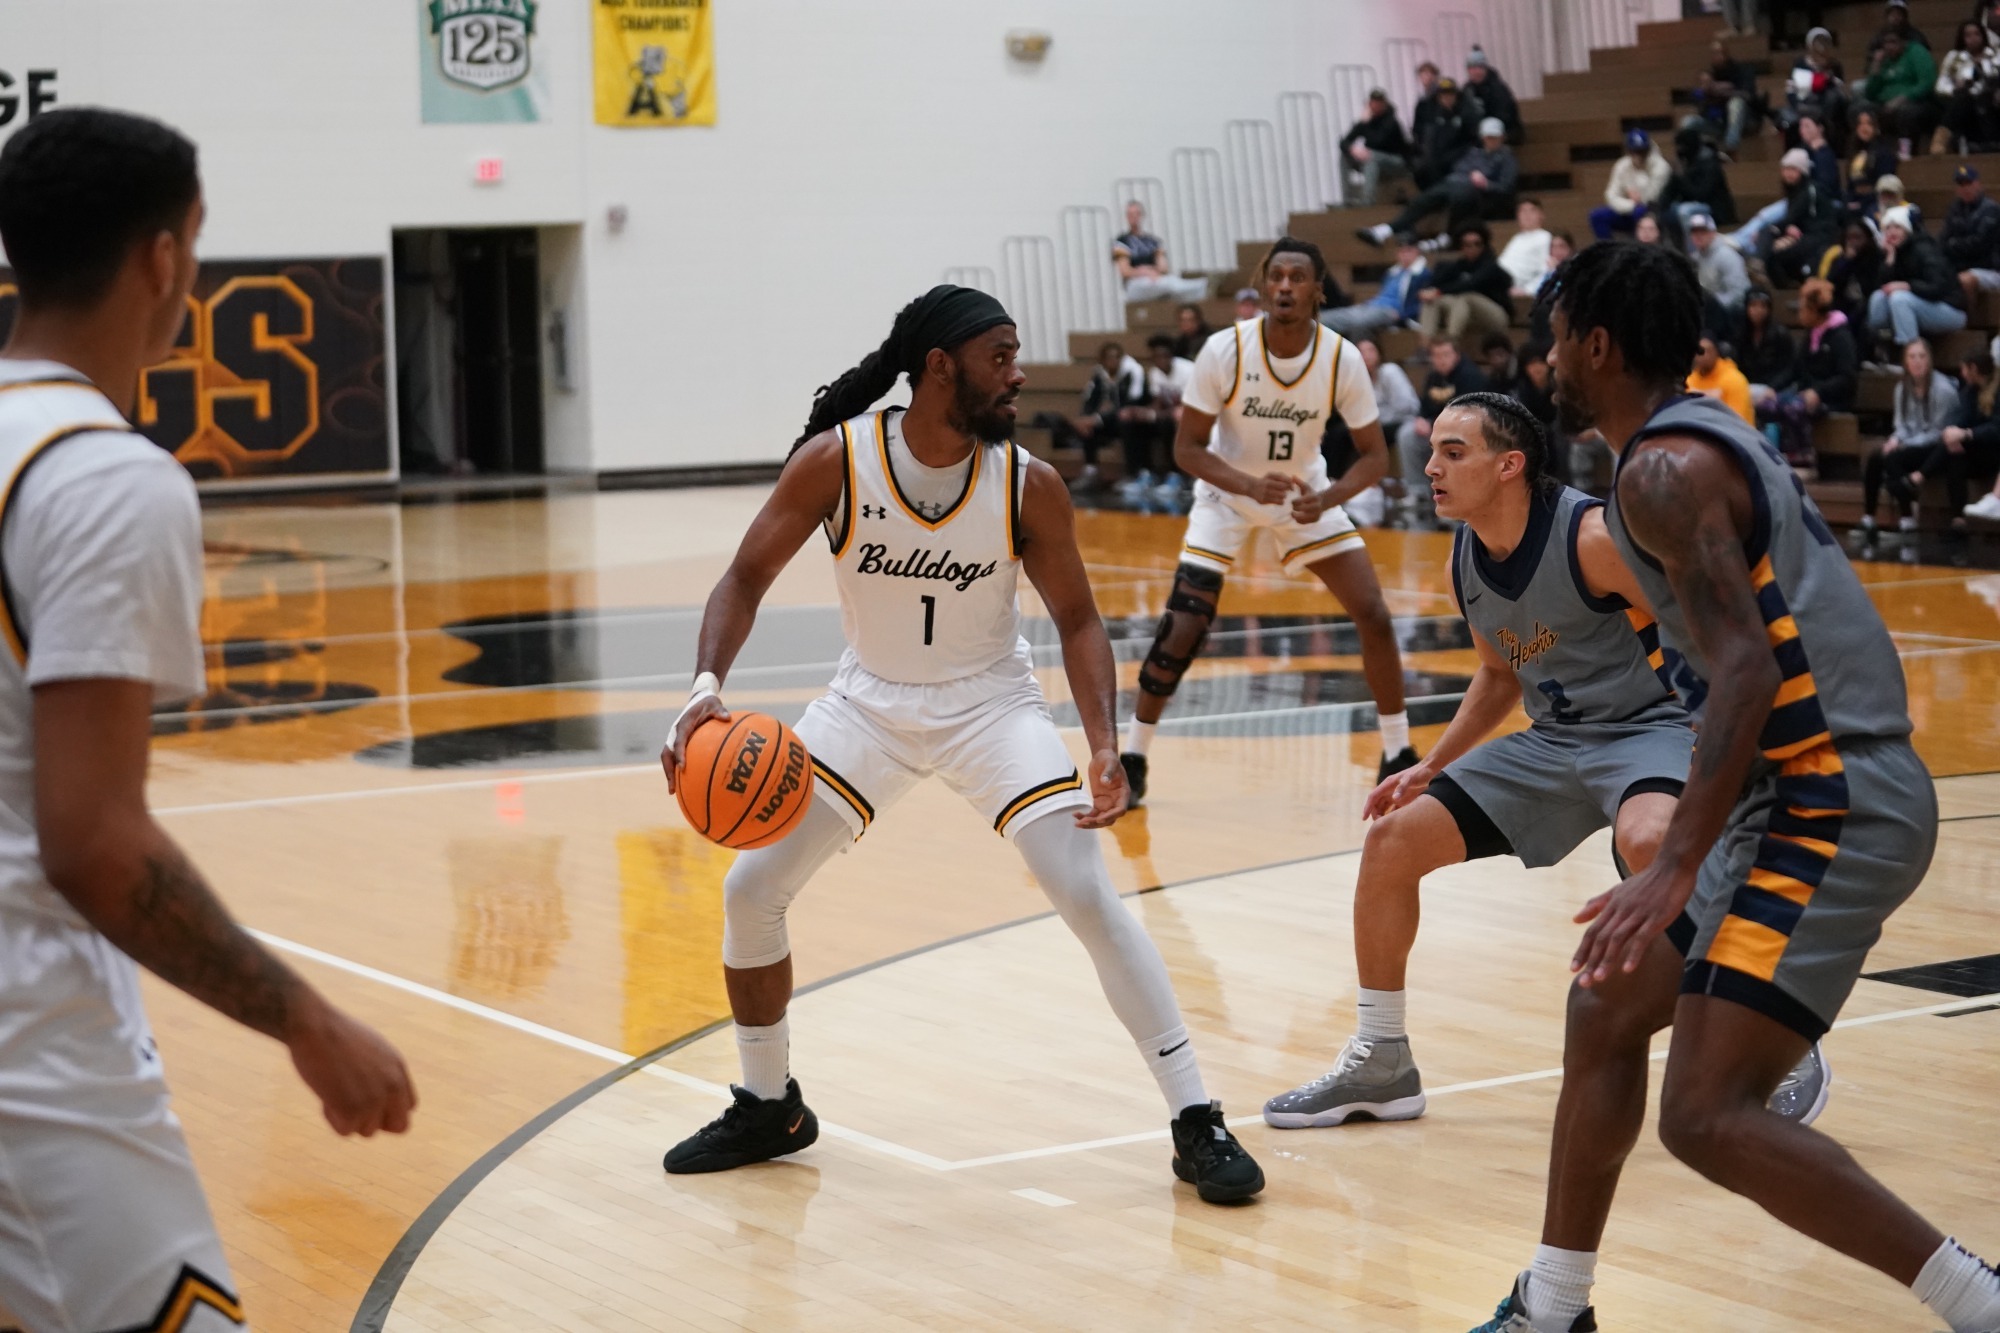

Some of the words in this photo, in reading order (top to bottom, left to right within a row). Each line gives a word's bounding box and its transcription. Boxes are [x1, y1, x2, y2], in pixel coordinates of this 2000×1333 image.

[450, 17, 524, 64] 125
[619, 15, 691, 31] CHAMPIONS
[1242, 397, 1319, 427] Bulldogs
[1267, 430, 1294, 461] 13
[857, 543, 997, 591] Bulldogs
[921, 595, 935, 645] 1
[1496, 627, 1516, 648] The
[1509, 620, 1559, 671] Heights
[726, 731, 767, 794] NCAA
[754, 741, 805, 823] Wilson
